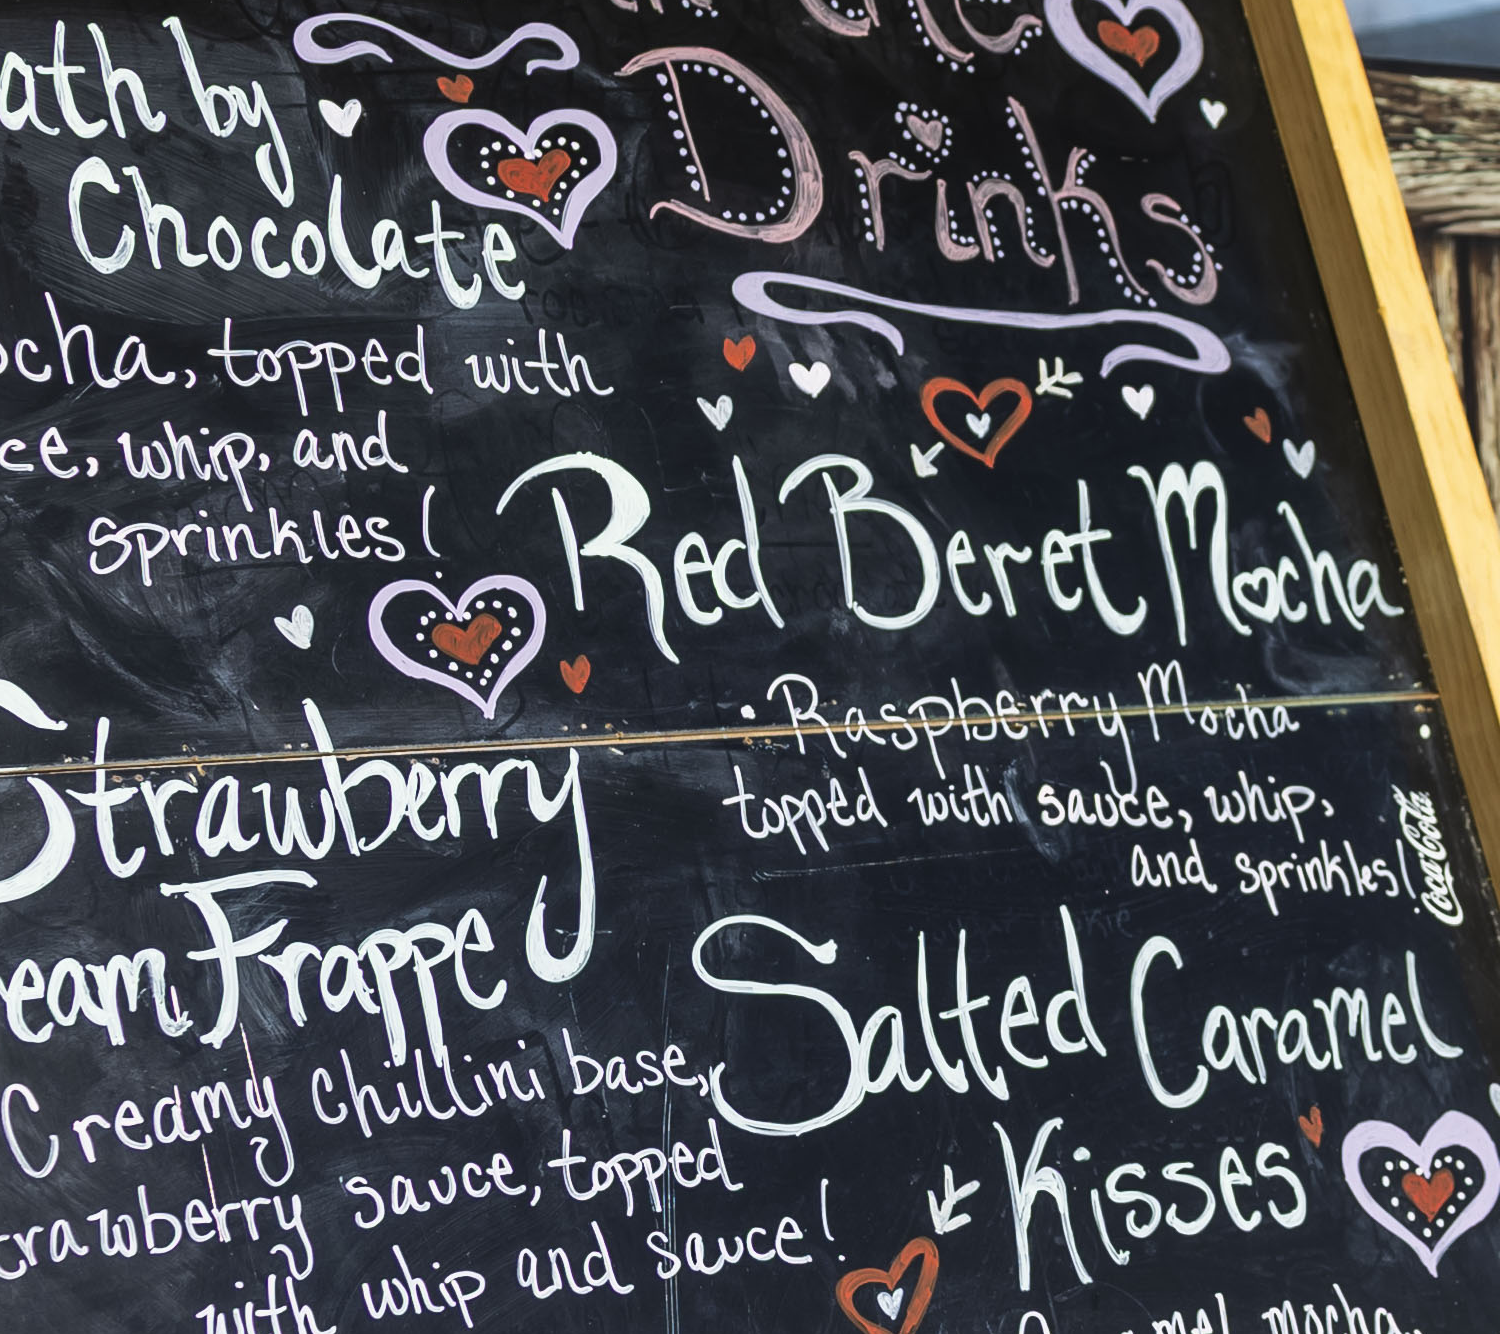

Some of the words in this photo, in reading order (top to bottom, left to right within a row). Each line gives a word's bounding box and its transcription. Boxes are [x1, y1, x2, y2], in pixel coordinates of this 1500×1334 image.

[164, 17, 294, 207] by
[615, 47, 1222, 308] Drinks
[69, 157, 526, 309] Chocolate
[208, 317, 433, 415] topped
[467, 328, 614, 396] with
[90, 486, 443, 585] sprinkles!
[118, 421, 270, 511] whip,
[294, 412, 408, 474] and
[496, 453, 784, 664] Red
[780, 453, 1147, 634] Beret
[1127, 461, 1404, 646] Mocha
[767, 674, 1139, 793] Raspberry
[1139, 660, 1301, 740] Mocha
[723, 767, 888, 854] topped
[908, 764, 1014, 828] with
[1039, 780, 1194, 835] sauce,
[1203, 772, 1335, 842] whip,
[1131, 842, 1217, 892] and
[1237, 837, 1420, 914] sprinkles!
[161, 870, 507, 1065] Frappe
[692, 907, 1105, 1134] Salted
[1133, 936, 1463, 1108] Caramel
[2, 1059, 298, 1187] Creamy
[562, 1028, 712, 1098] base,
[345, 1149, 541, 1229] sauce,
[548, 1119, 744, 1218] topped
[361, 1245, 487, 1327] whip
[516, 1222, 634, 1300] and
[657, 1179, 845, 1280] sauce!
[993, 1117, 1307, 1292] Kisses
